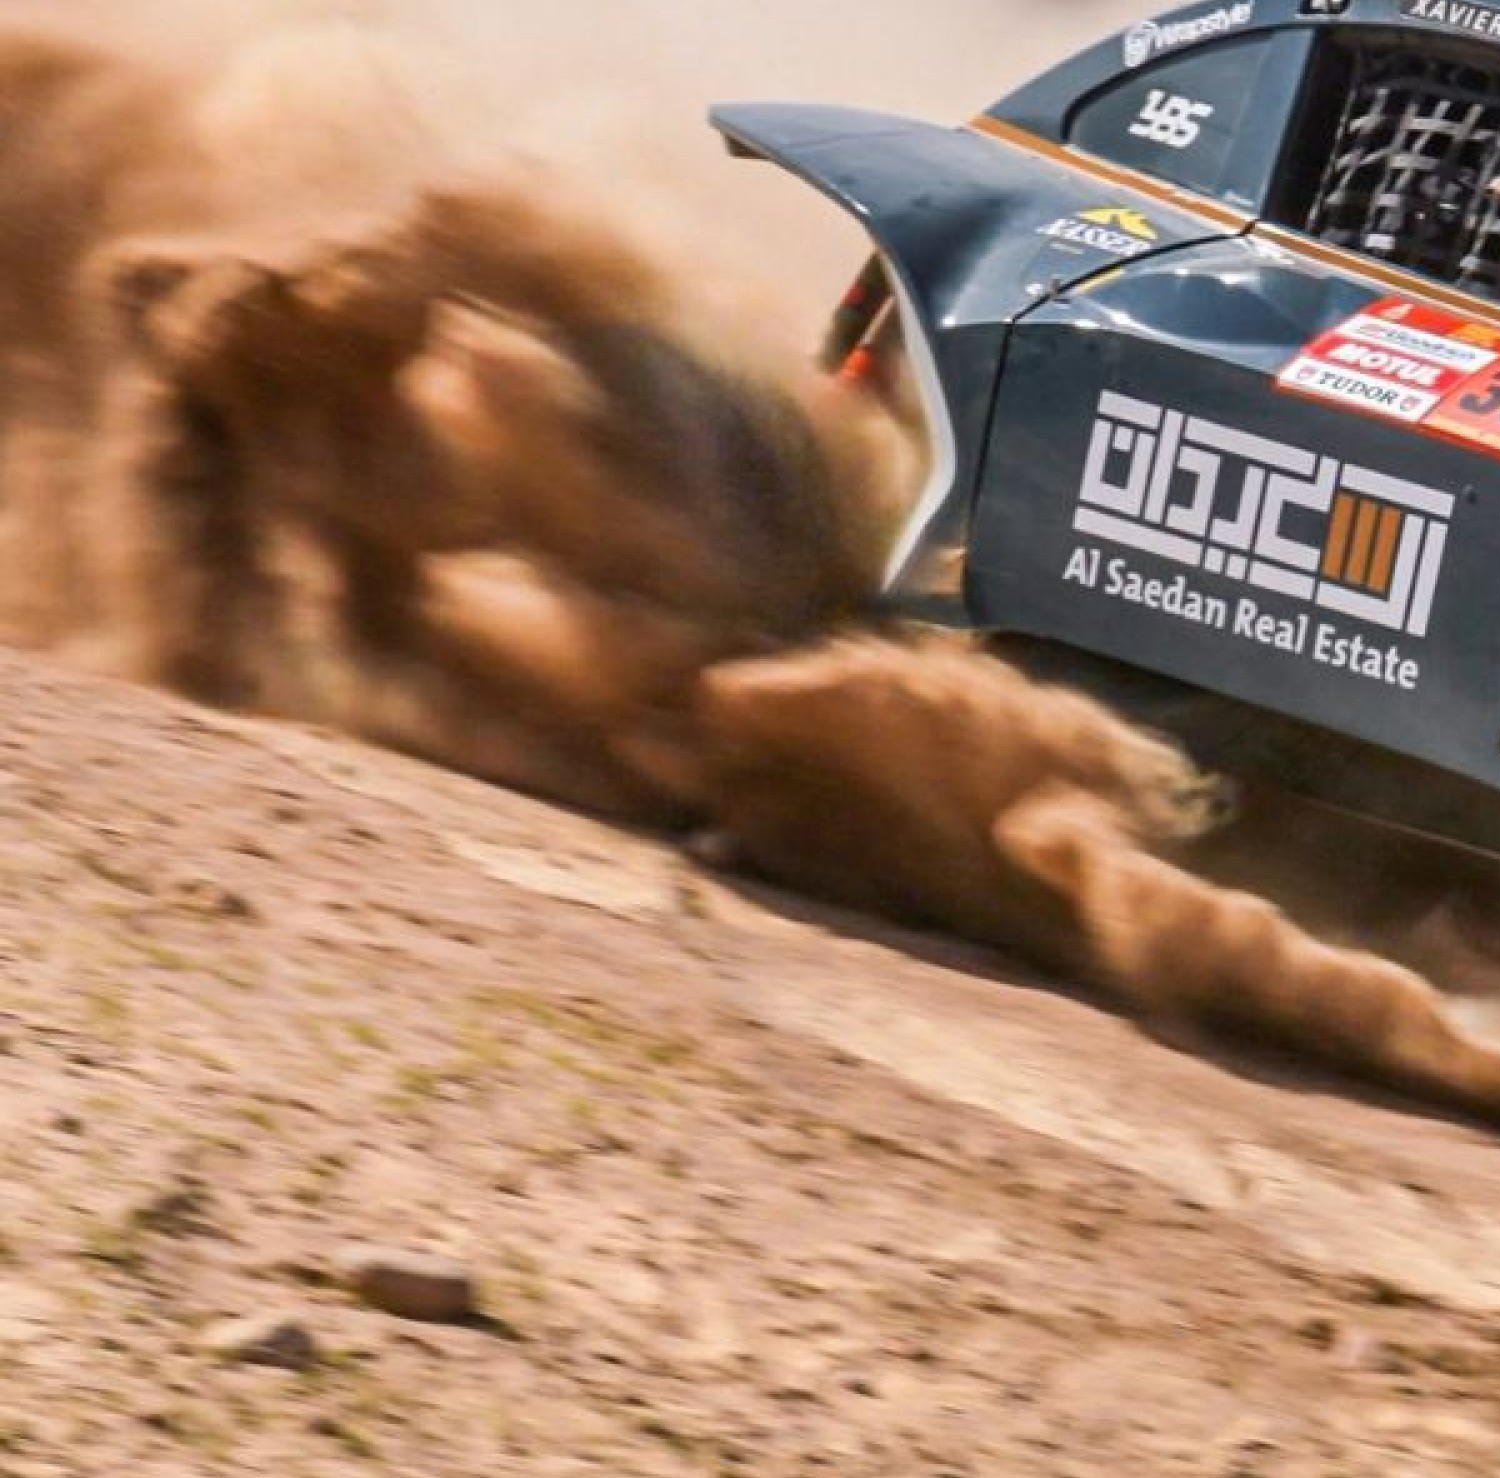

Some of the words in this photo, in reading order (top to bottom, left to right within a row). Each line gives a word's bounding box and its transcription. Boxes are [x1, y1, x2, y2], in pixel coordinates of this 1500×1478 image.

[1327, 343, 1441, 386] MOTUL
[1319, 371, 1399, 405] TUDOR
[1063, 548, 1099, 588] Al
[1104, 558, 1226, 629] Saedan
[1232, 598, 1308, 654] Real
[1313, 623, 1418, 689] Estate
